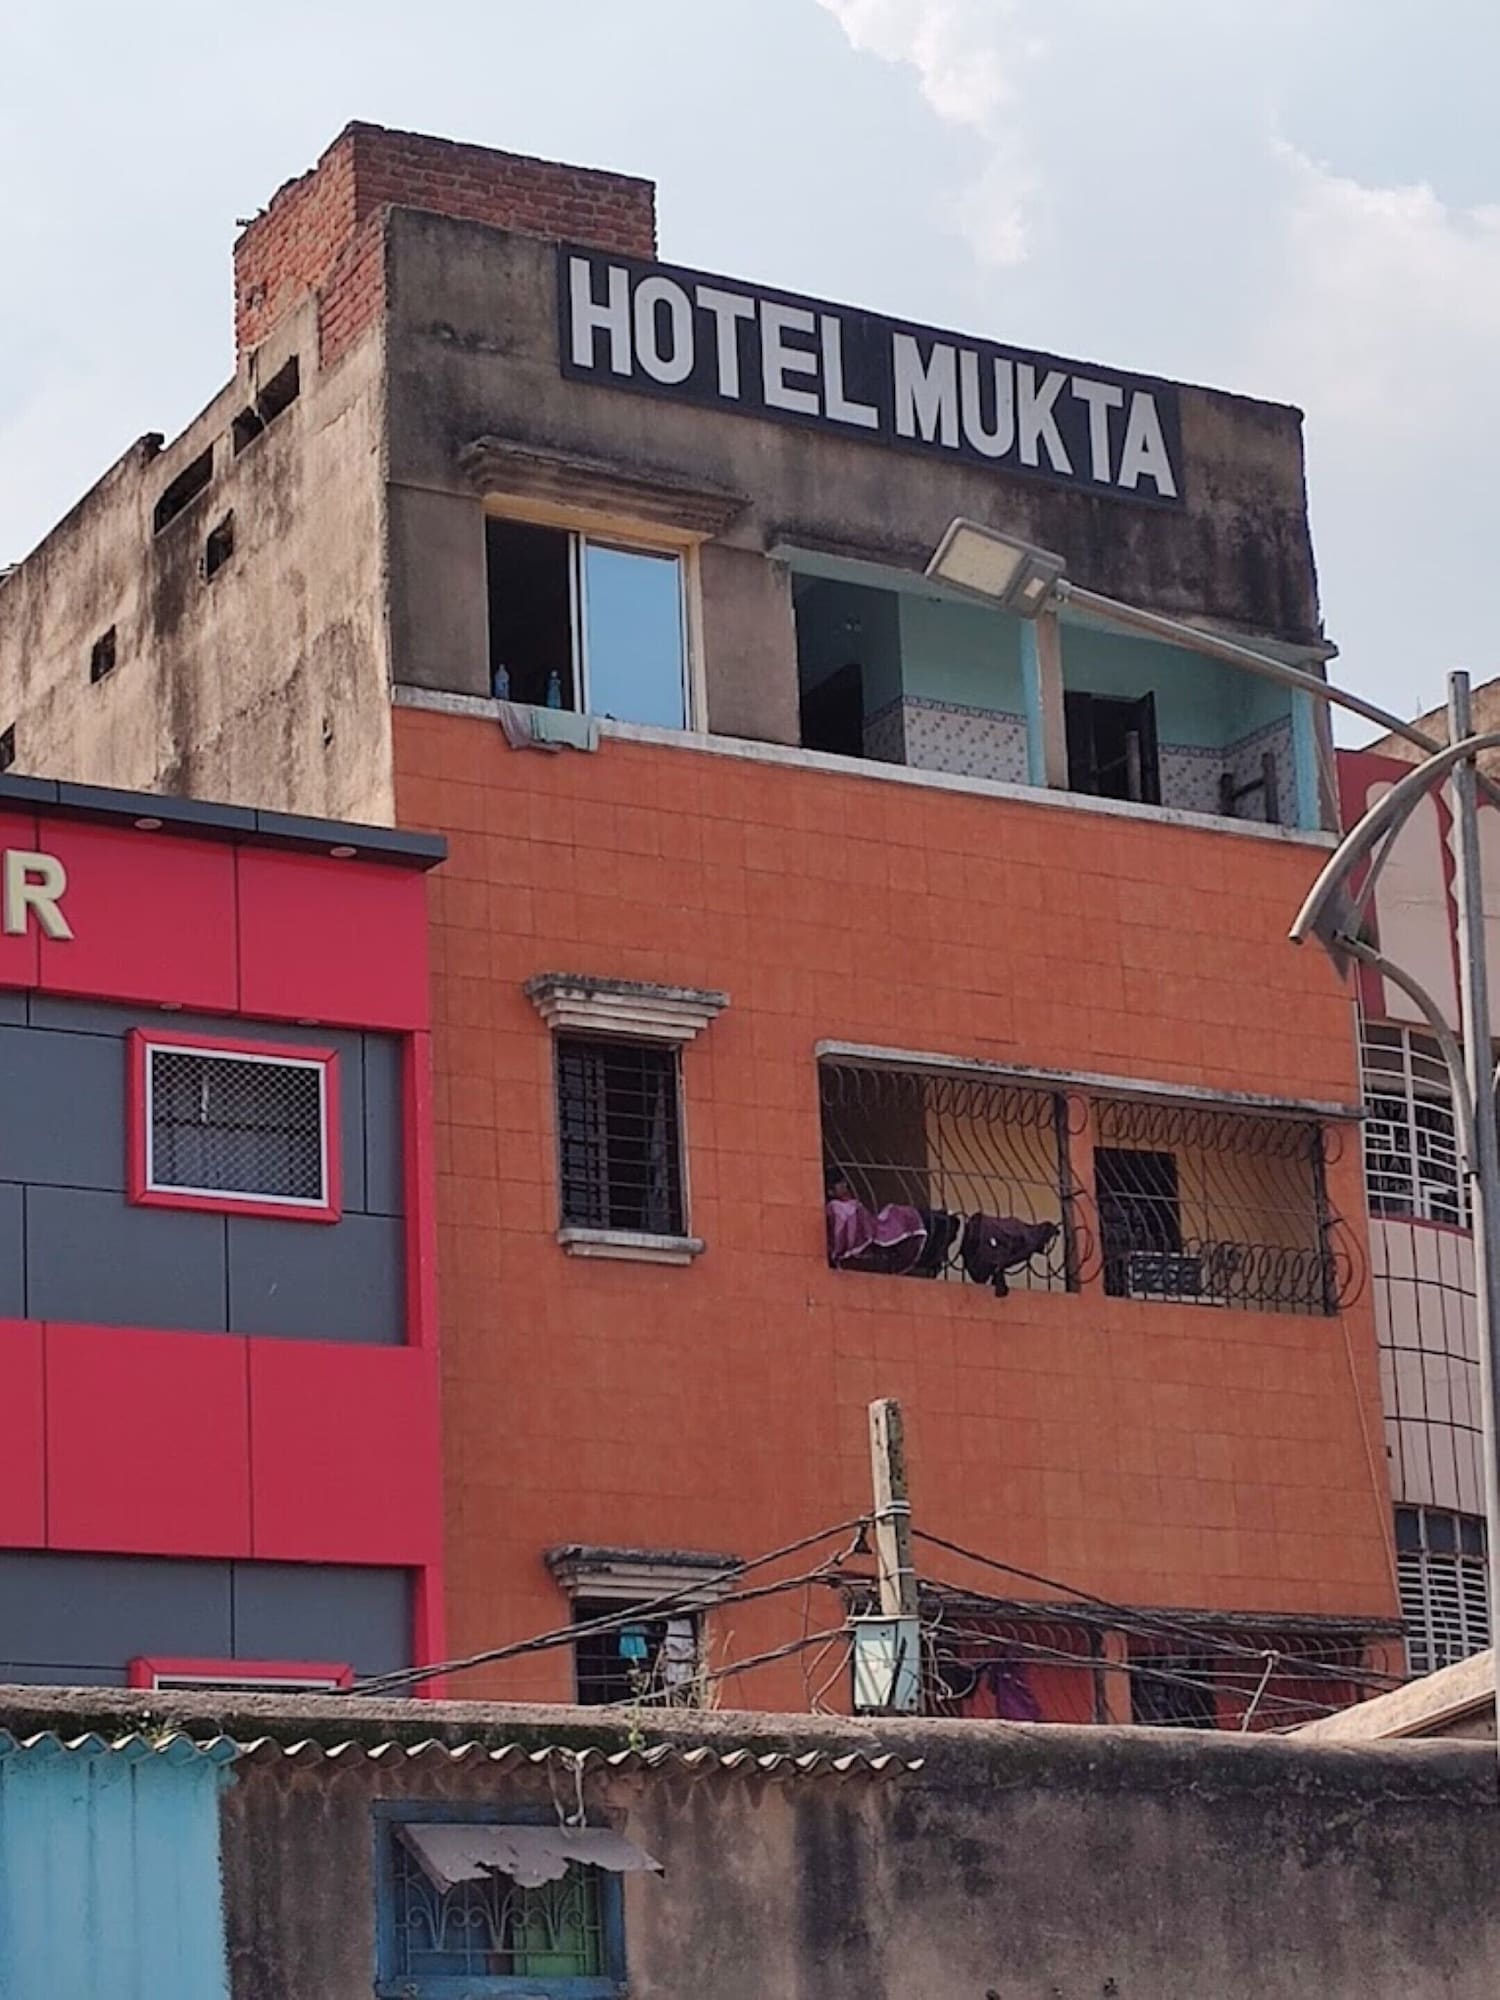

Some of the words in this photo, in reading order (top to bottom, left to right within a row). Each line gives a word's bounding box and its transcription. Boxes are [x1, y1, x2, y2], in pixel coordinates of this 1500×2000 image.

[569, 256, 879, 430] HOTEL
[893, 332, 1178, 498] MUKTA
[3, 848, 75, 940] R
